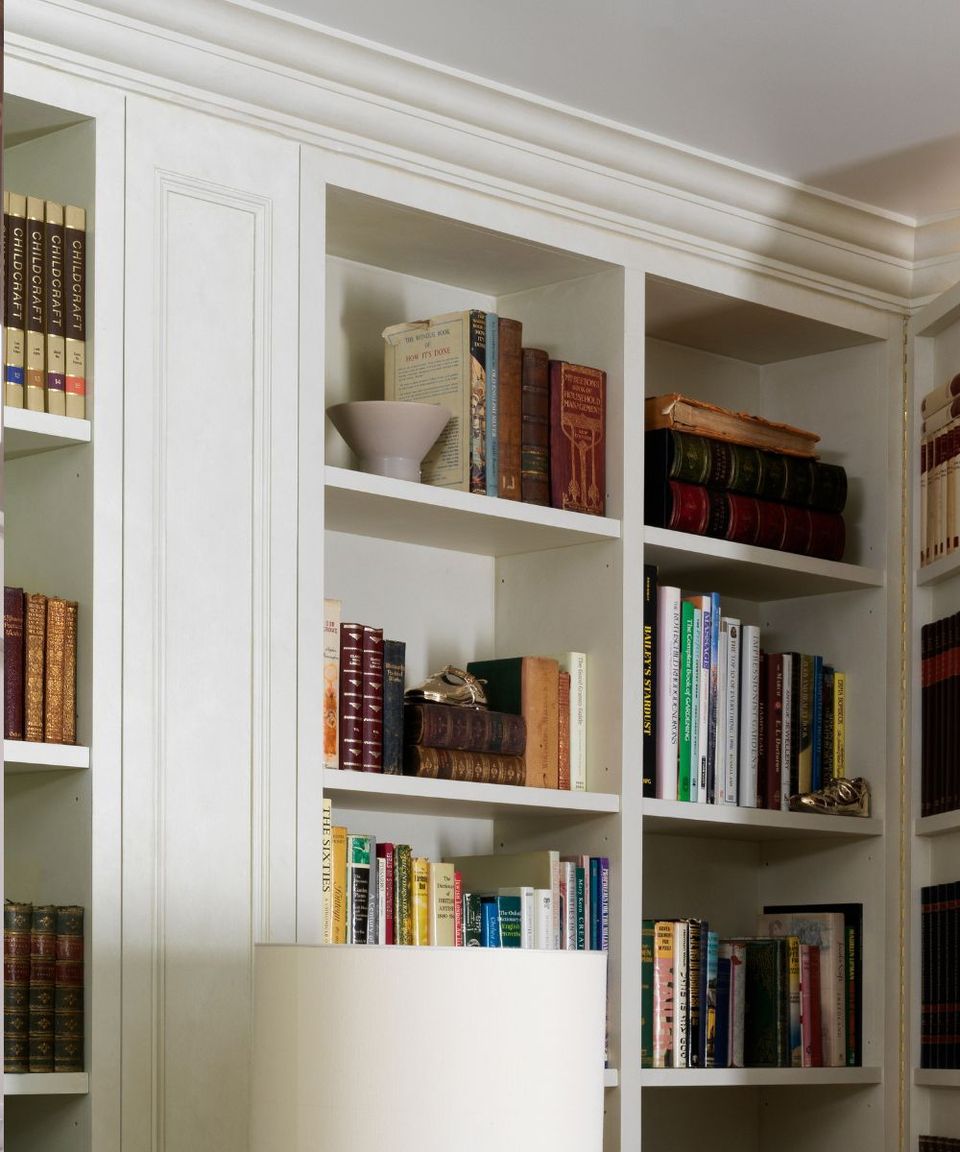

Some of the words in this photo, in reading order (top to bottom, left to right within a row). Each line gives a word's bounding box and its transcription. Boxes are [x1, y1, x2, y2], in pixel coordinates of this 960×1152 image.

[13, 227, 24, 321] CHILDCRAFT
[32, 231, 42, 324] CHILDCRAFT
[51, 235, 62, 327] CHILDCRAFT
[73, 240, 82, 332] CHILDCRAFT
[564, 391, 601, 405] HOUSEHOLD
[643, 625, 652, 677] BAILEY'S
[684, 633, 692, 668] Complete
[703, 611, 711, 670] MASSAGE
[684, 687, 692, 697] of
[730, 679, 736, 689] OF
[751, 635, 759, 718] IMPRESSIONIST
[643, 679, 652, 737] STARDUST
[322, 806, 331, 836] THE
[322, 839, 331, 893] SIXTIES
[368, 893, 376, 901] A
[368, 902, 376, 933] Century
[368, 935, 376, 944] of
